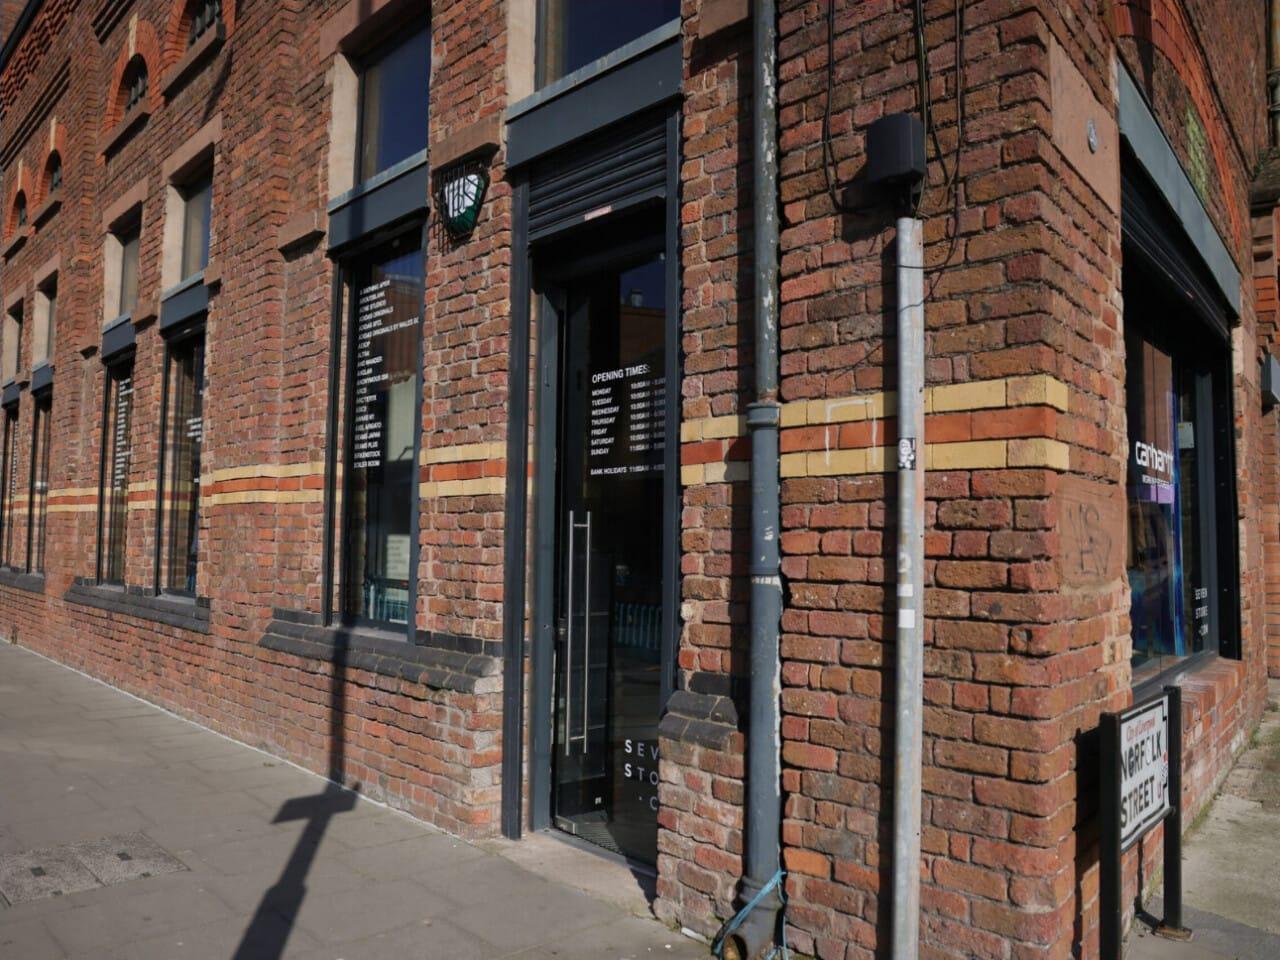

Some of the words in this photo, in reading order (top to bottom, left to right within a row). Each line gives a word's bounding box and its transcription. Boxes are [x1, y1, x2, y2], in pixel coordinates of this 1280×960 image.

[592, 369, 624, 384] OPENING
[625, 364, 651, 377] TIMES:
[592, 387, 612, 397] MONDAY
[592, 397, 613, 407] TUESDAY
[592, 406, 620, 416] WEDNESDAY
[592, 416, 616, 426] THURSDAY
[591, 428, 608, 436] FRIDAY
[591, 437, 615, 446] SATURDAY
[591, 448, 609, 456] SUNDAY
[590, 467, 603, 476] BANK
[603, 466, 627, 474] HOLIDAYS
[1121, 729, 1162, 781] NORFOLK
[1121, 775, 1155, 829] STREET
